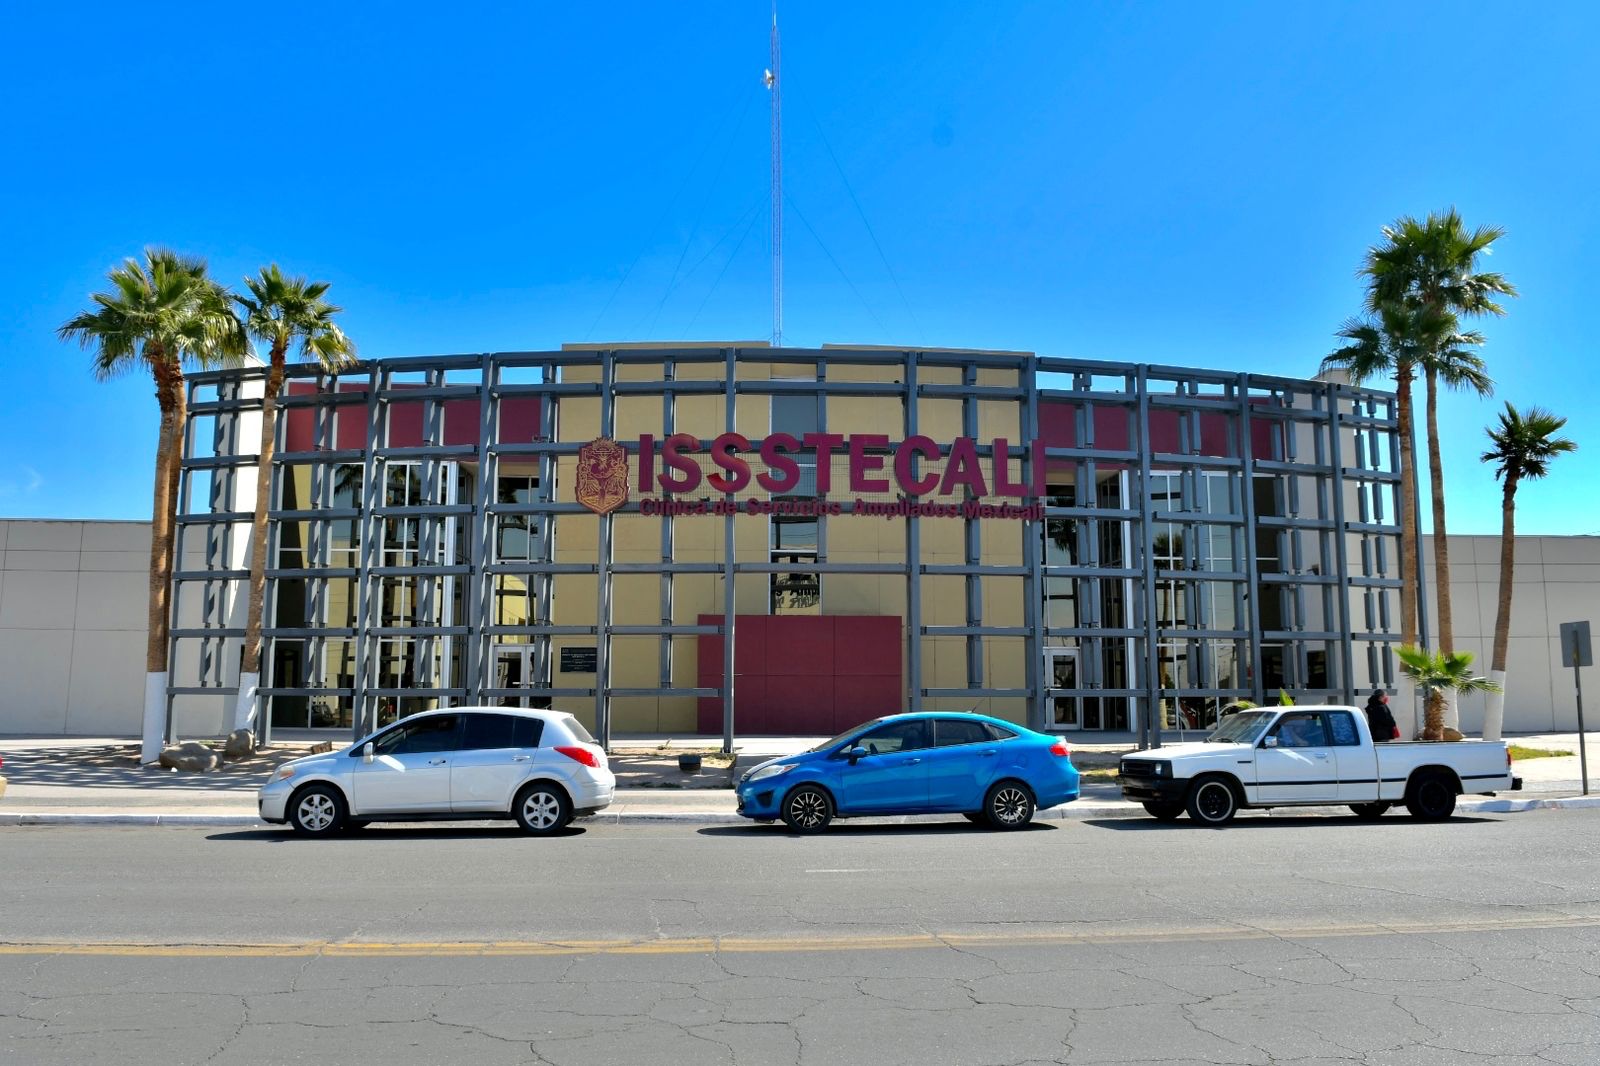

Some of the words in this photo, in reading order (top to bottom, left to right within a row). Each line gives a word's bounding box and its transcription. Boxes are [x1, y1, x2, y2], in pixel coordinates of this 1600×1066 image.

[638, 432, 1046, 497] ISSSTECALI
[713, 498, 738, 516] de
[746, 497, 842, 516] Servicios
[851, 498, 959, 520] Ampliados
[961, 499, 1045, 520] Mexicali
